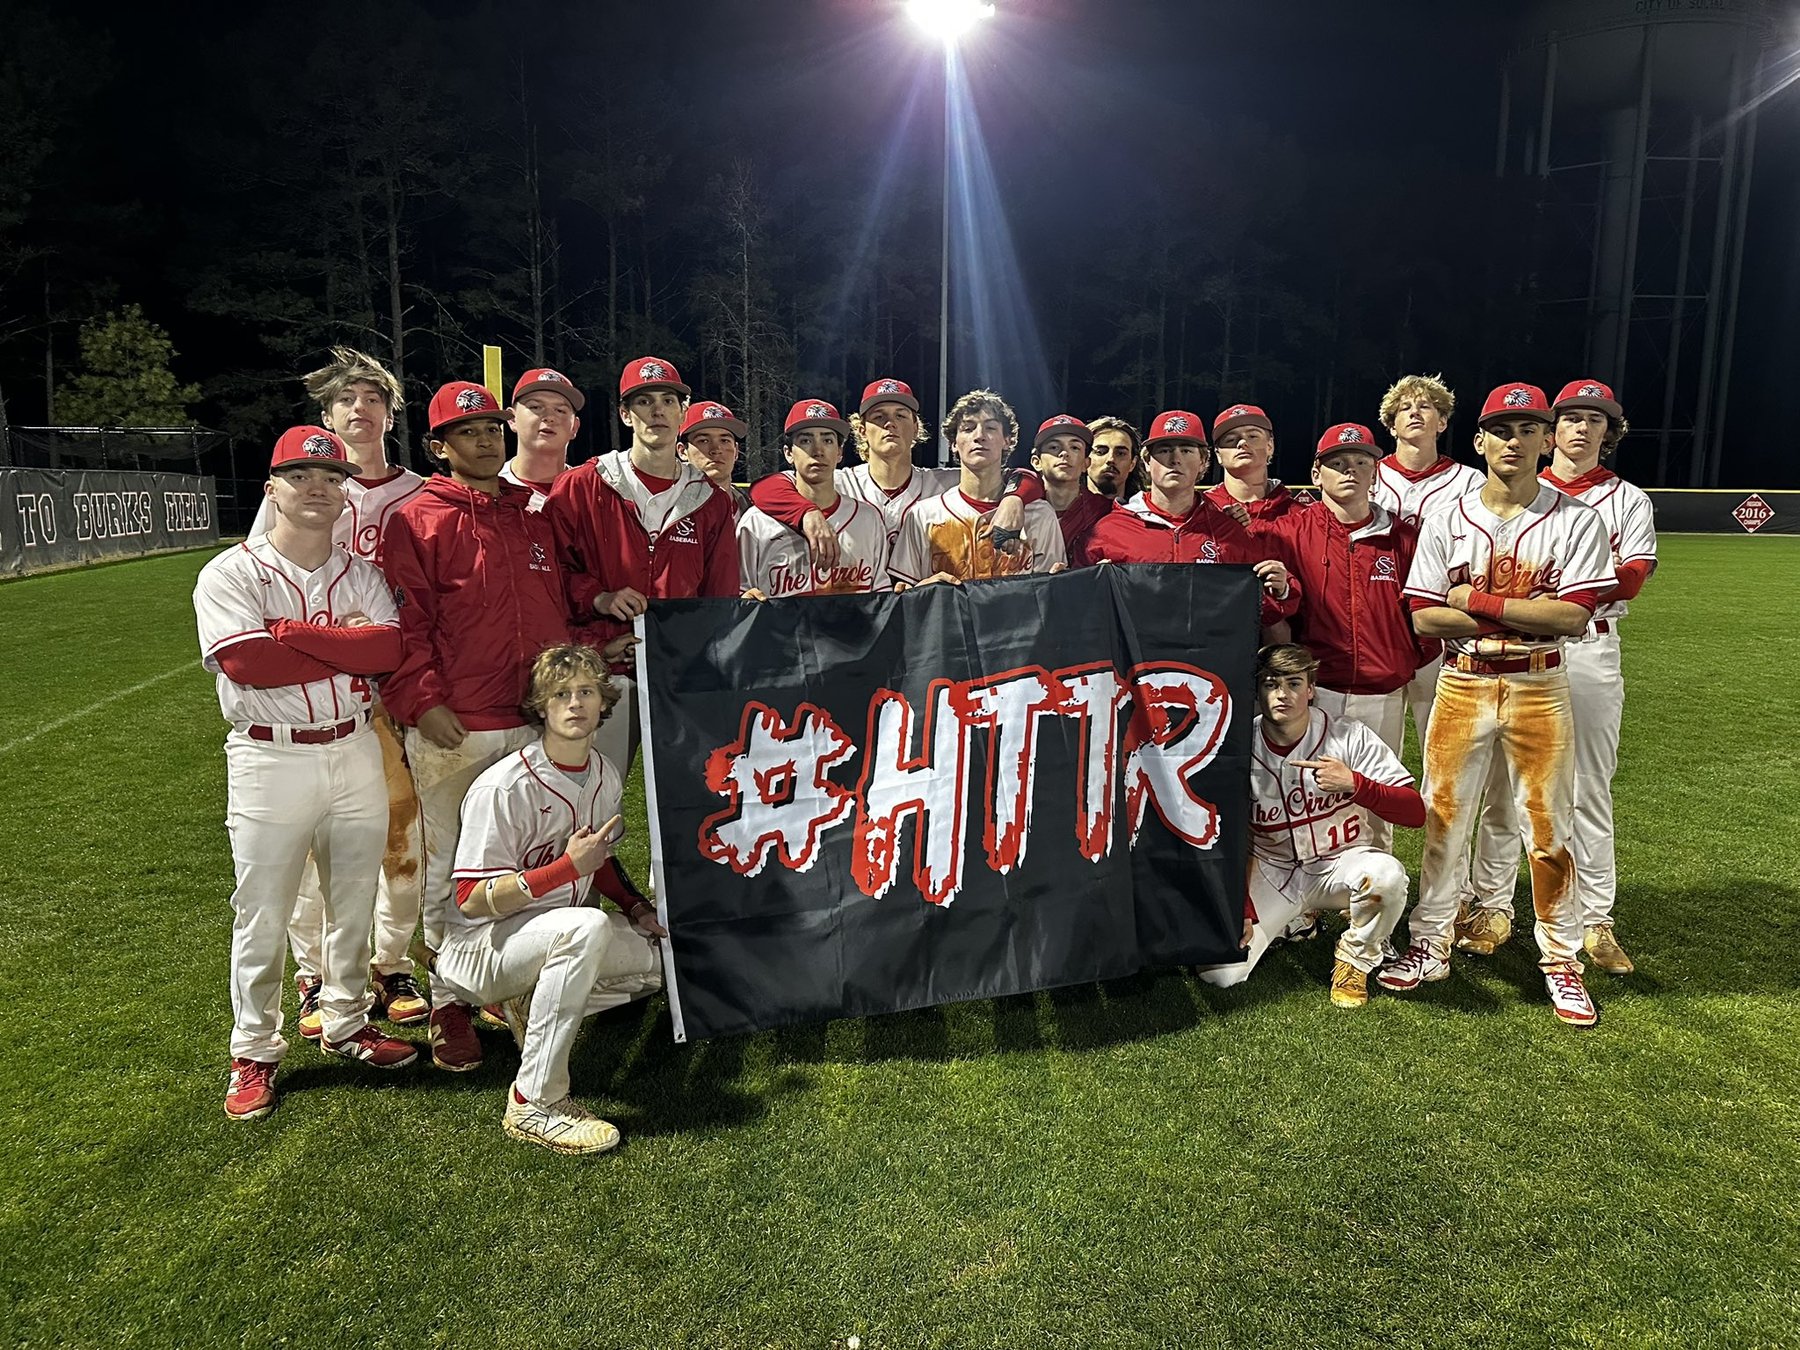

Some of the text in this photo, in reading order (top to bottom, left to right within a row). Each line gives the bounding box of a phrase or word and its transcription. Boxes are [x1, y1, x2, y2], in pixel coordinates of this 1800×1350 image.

[17, 491, 210, 547] TO BURKS FIELD
[1738, 507, 1767, 519] 2016
[769, 564, 808, 597] The
[1492, 555, 1561, 590] Circle
[698, 660, 1233, 908] #HTTR
[1326, 814, 1361, 851] 16
